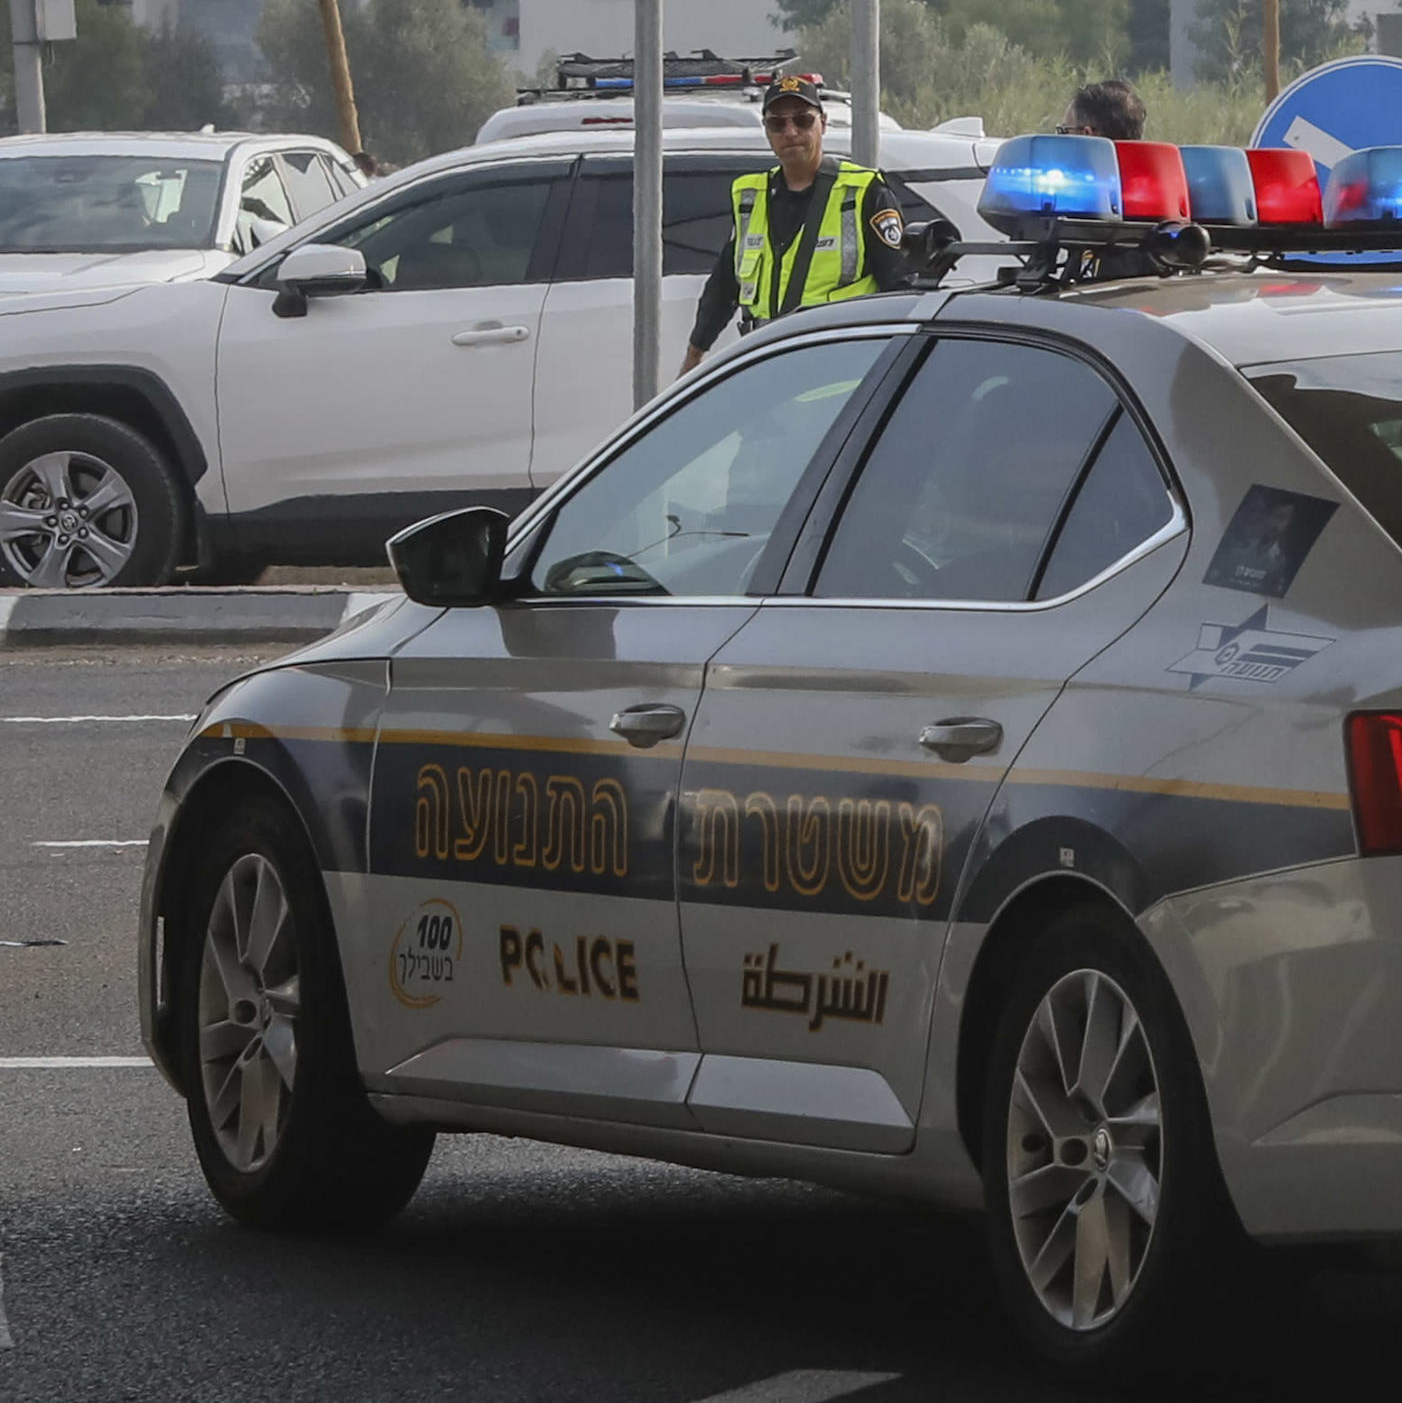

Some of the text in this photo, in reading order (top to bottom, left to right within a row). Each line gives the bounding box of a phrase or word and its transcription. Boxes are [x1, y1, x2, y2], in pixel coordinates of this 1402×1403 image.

[415, 763, 944, 906] משטרת התנועה
[399, 946, 454, 985] בשבילך
[417, 914, 453, 950] 100
[499, 923, 640, 1003] POLICE
[741, 942, 891, 1033] الشرطة
